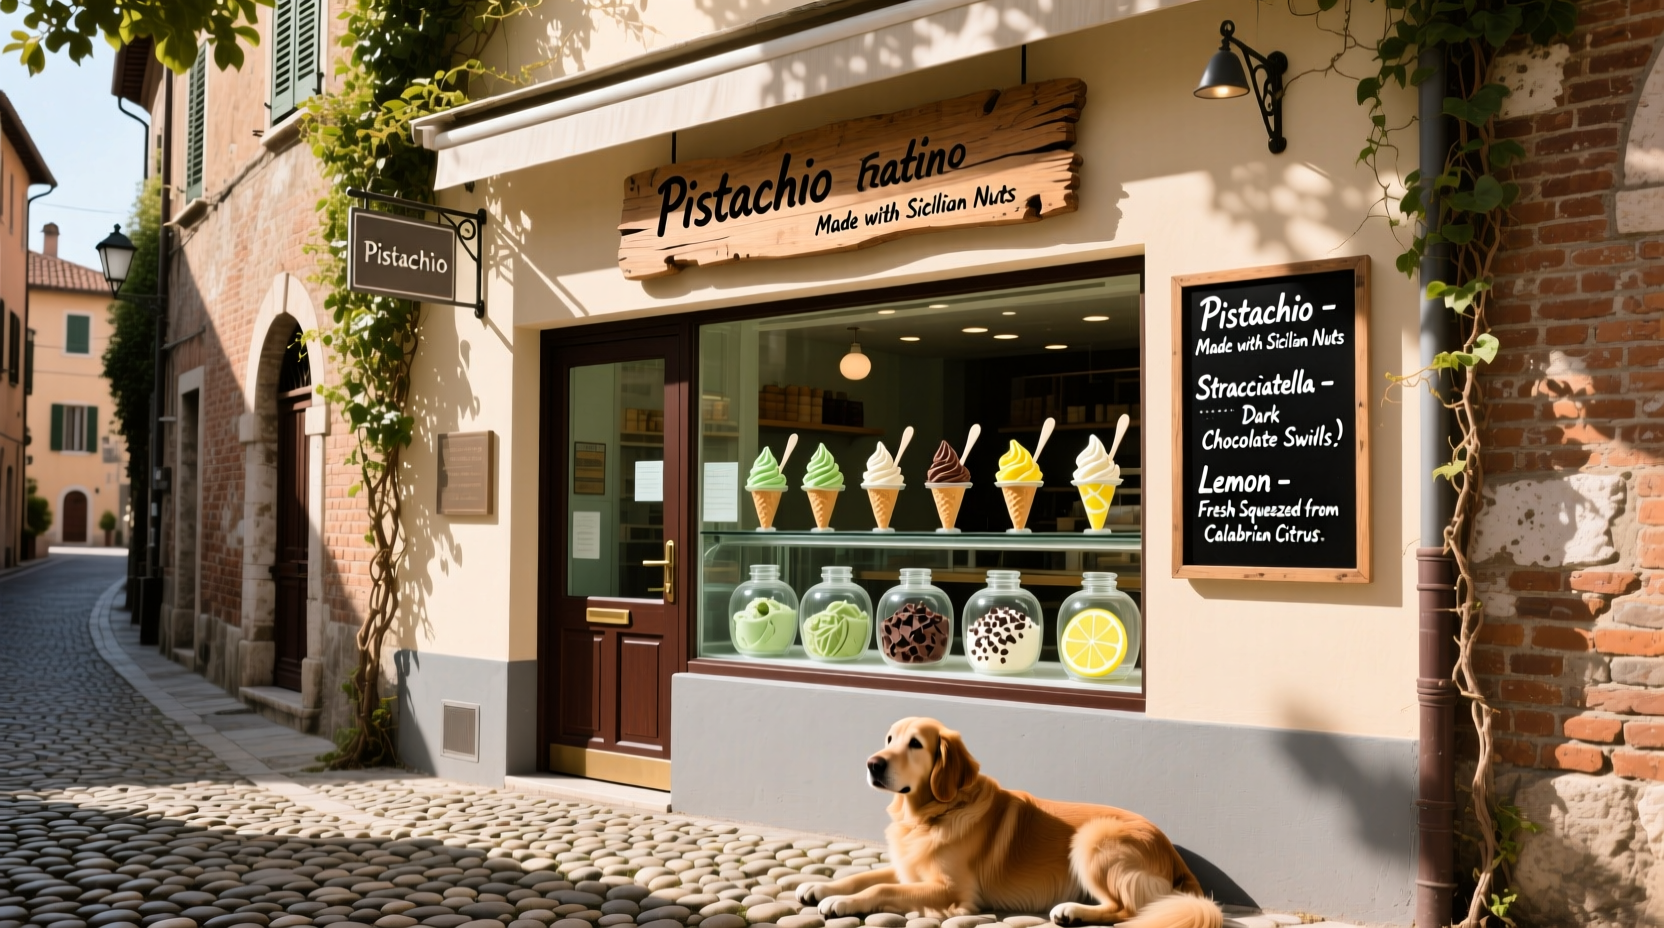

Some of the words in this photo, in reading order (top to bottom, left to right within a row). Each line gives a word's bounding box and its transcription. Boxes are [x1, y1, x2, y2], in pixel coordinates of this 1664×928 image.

[657, 153, 832, 238] Pistachio
[815, 213, 859, 236] Made
[865, 202, 900, 226] with
[973, 184, 1017, 209] Nuts
[363, 240, 448, 274] Pistachio
[1199, 291, 1314, 332] Pistachio
[1195, 335, 1233, 356] Made
[1237, 333, 1263, 352] with
[1311, 327, 1345, 347] Nuts
[1195, 368, 1316, 401] Stracciatella
[1241, 404, 1280, 425] Dark
[1201, 428, 1278, 451] Chocolate
[1198, 464, 1271, 494] Lemon
[1197, 499, 1236, 518] Fresh
[1304, 497, 1340, 518] from
